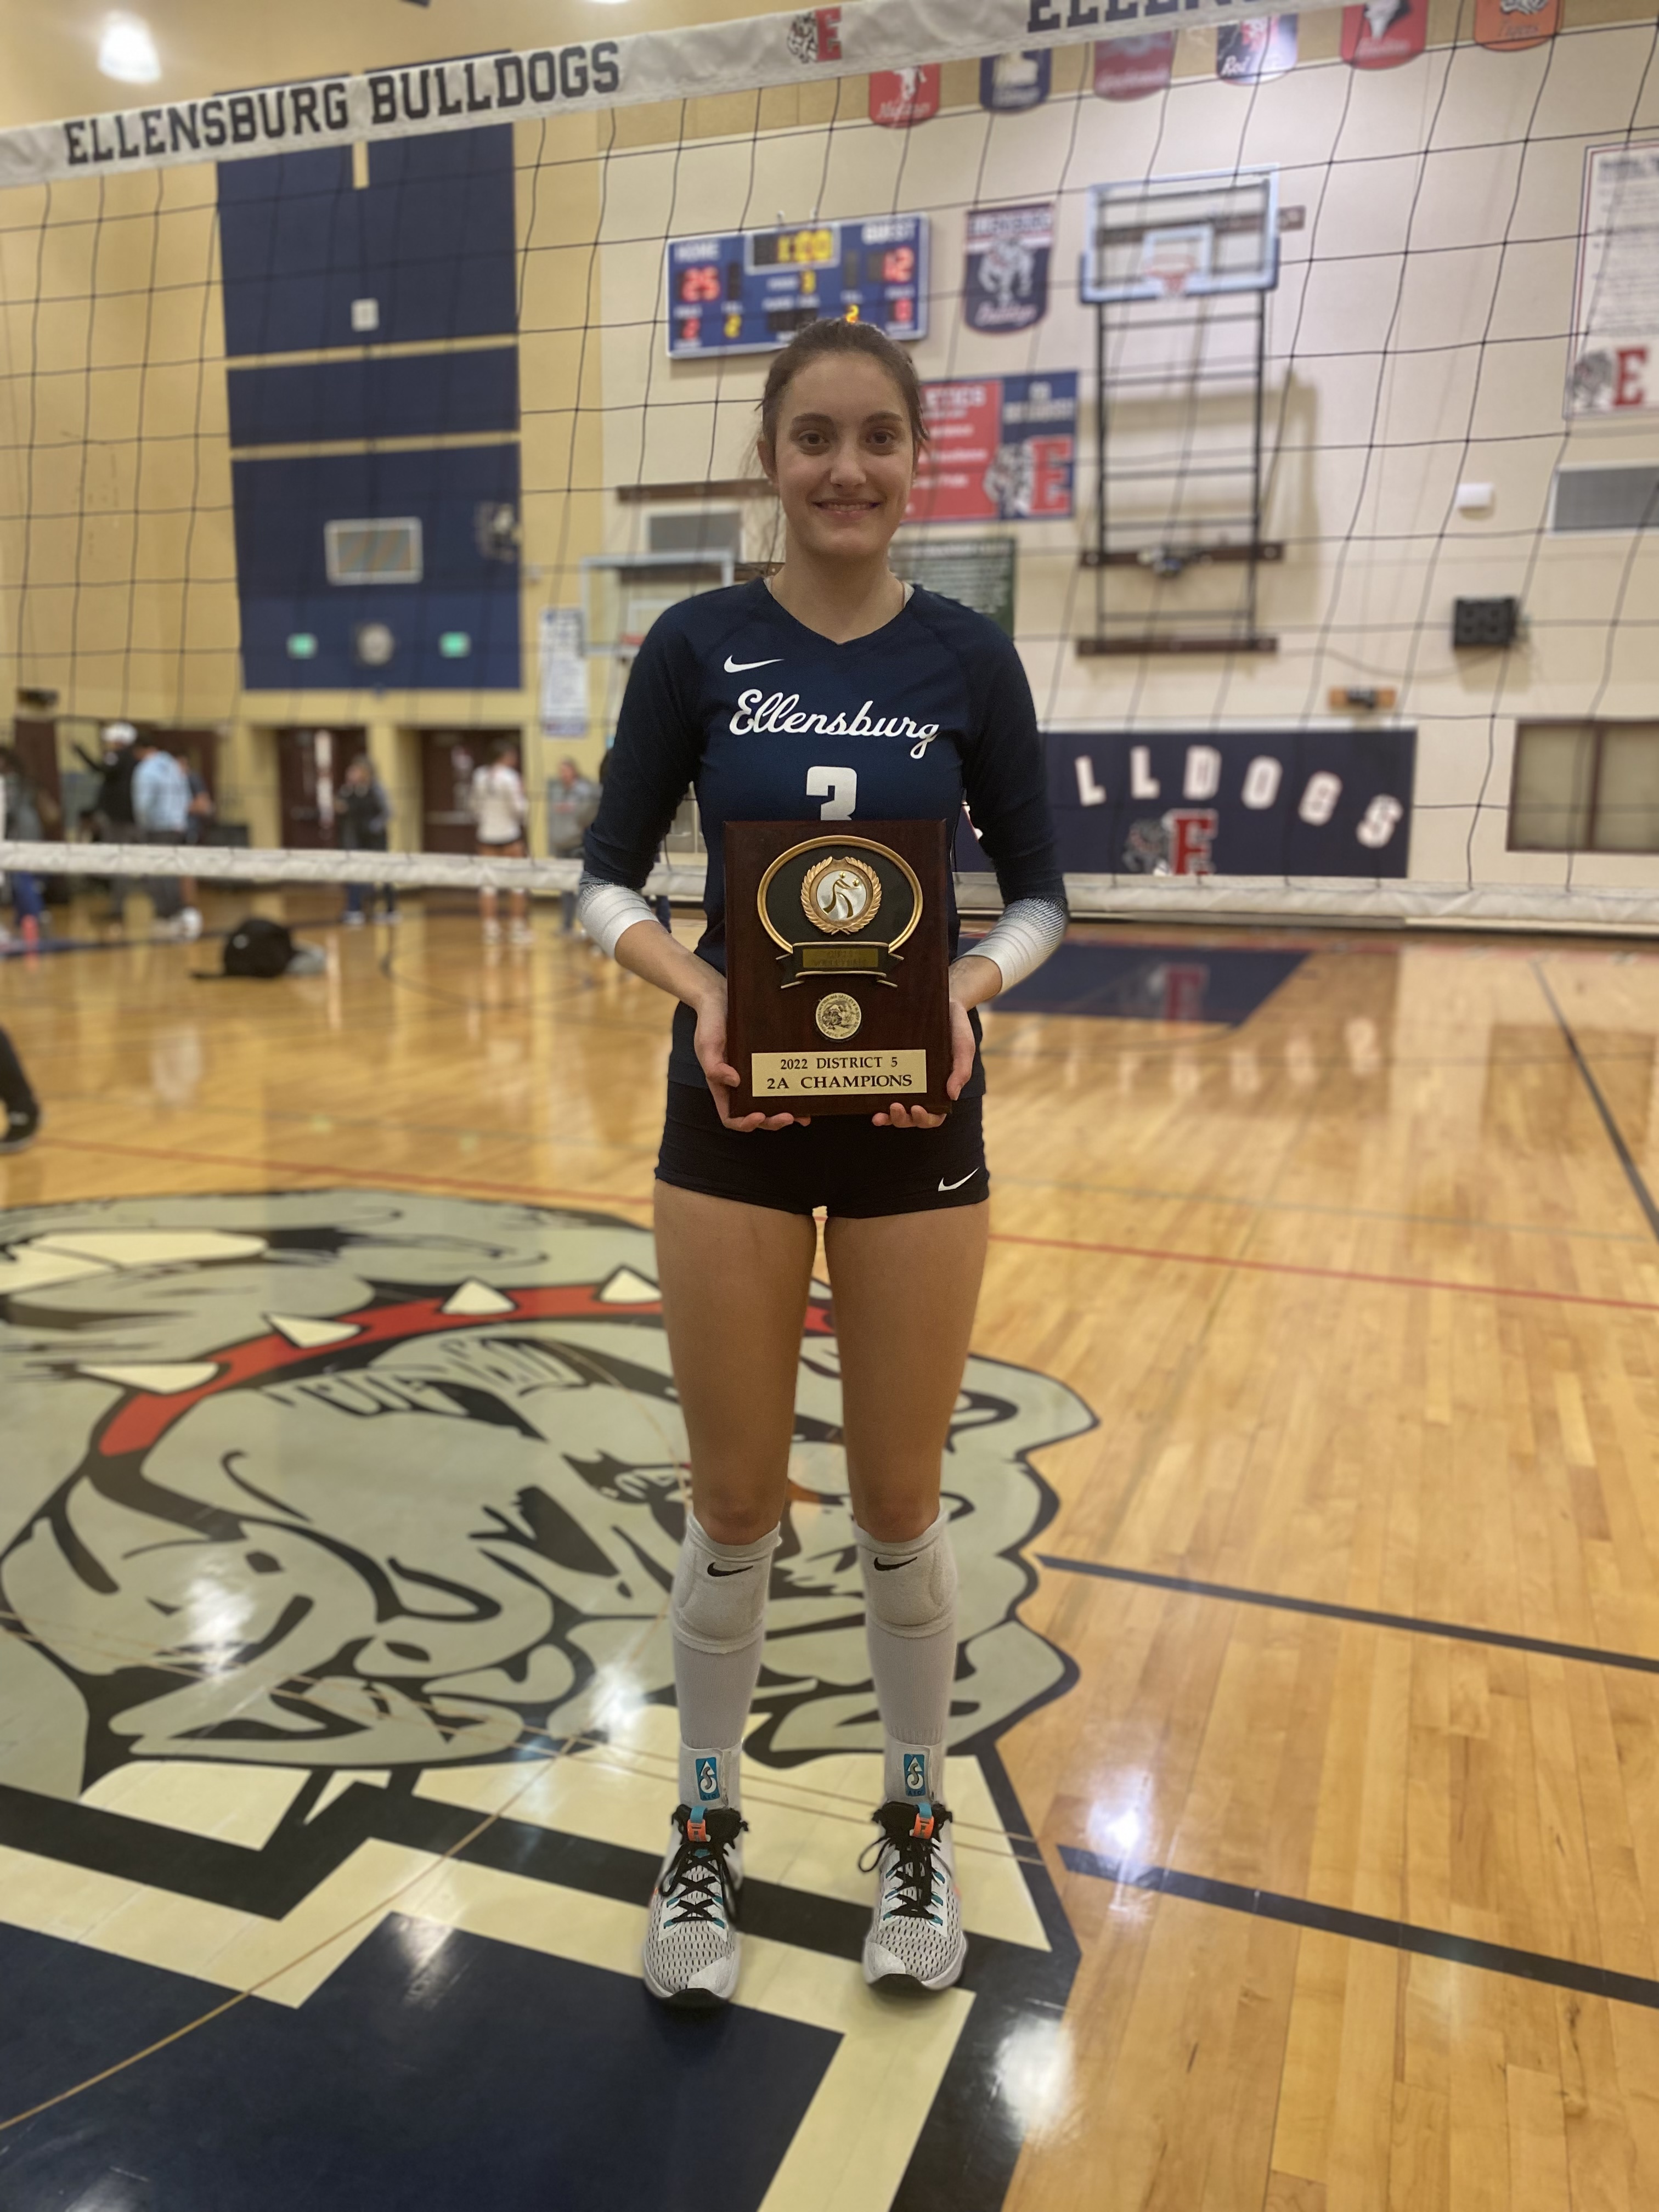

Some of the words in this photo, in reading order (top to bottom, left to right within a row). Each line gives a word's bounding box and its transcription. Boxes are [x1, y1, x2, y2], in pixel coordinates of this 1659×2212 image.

[64, 82, 349, 166] ELLENSBURG
[368, 41, 619, 126] BULLDOGS
[1612, 345, 1649, 408] E
[729, 689, 941, 759] Ellensburg
[767, 1077, 789, 1089] 2A
[800, 1074, 912, 1088] CHAMPIONS
[780, 1058, 808, 1070] 2022
[816, 1057, 883, 1069] DISTRICT
[890, 1057, 898, 1068] 5
